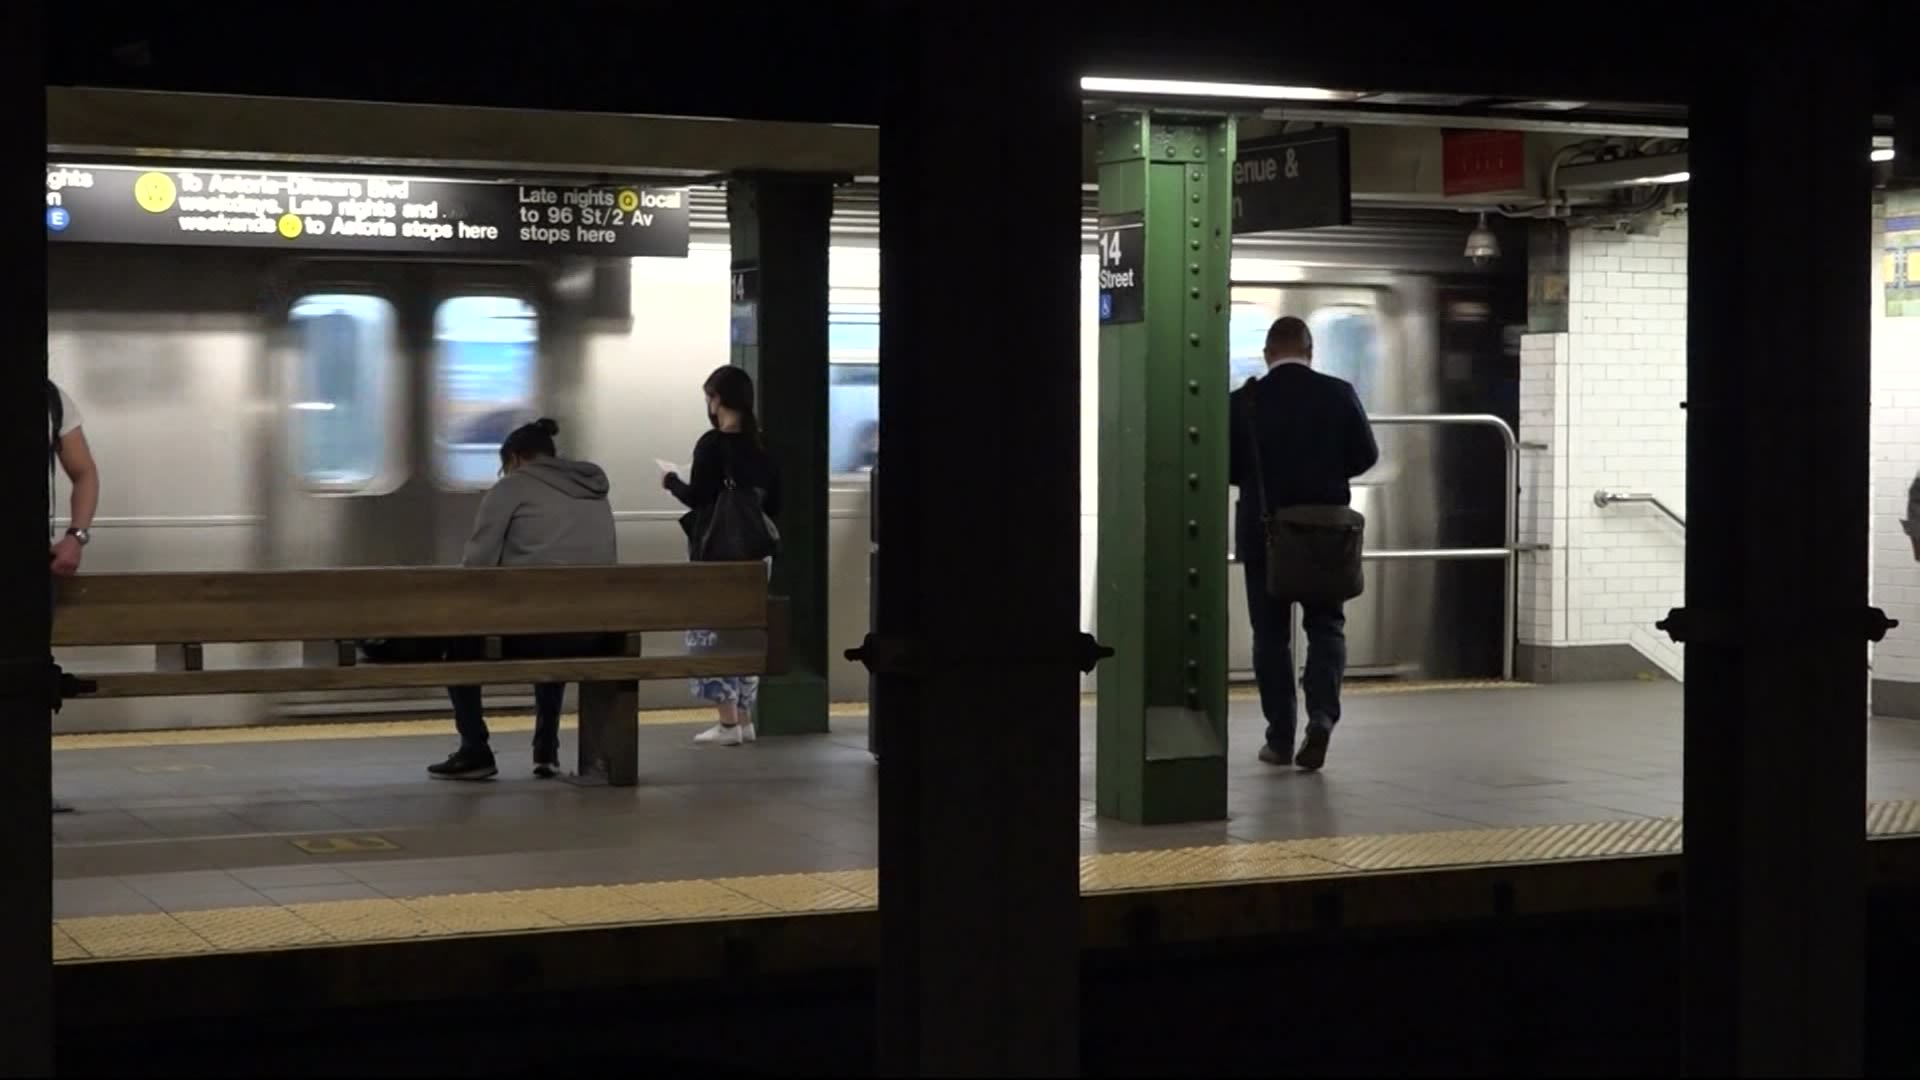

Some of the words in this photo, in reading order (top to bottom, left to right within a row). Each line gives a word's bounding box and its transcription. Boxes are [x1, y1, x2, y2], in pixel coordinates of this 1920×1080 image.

[1284, 148, 1299, 178] &
[177, 173, 203, 192] To
[519, 187, 557, 204] Late
[564, 188, 614, 207] nights
[641, 190, 681, 208] local
[289, 196, 333, 215] Late
[338, 198, 396, 221] nights
[402, 200, 437, 219] and
[520, 207, 539, 223] to
[547, 208, 573, 225] 96
[581, 208, 624, 227] St/2
[631, 211, 654, 227] Av
[178, 213, 276, 233] weekends
[305, 216, 325, 235] to
[331, 216, 396, 236] Astoria
[402, 220, 452, 240] stops
[459, 221, 497, 239] here
[520, 225, 570, 245] stops
[577, 226, 616, 243] here
[1100, 231, 1122, 266] 14
[1100, 268, 1134, 289] Street
